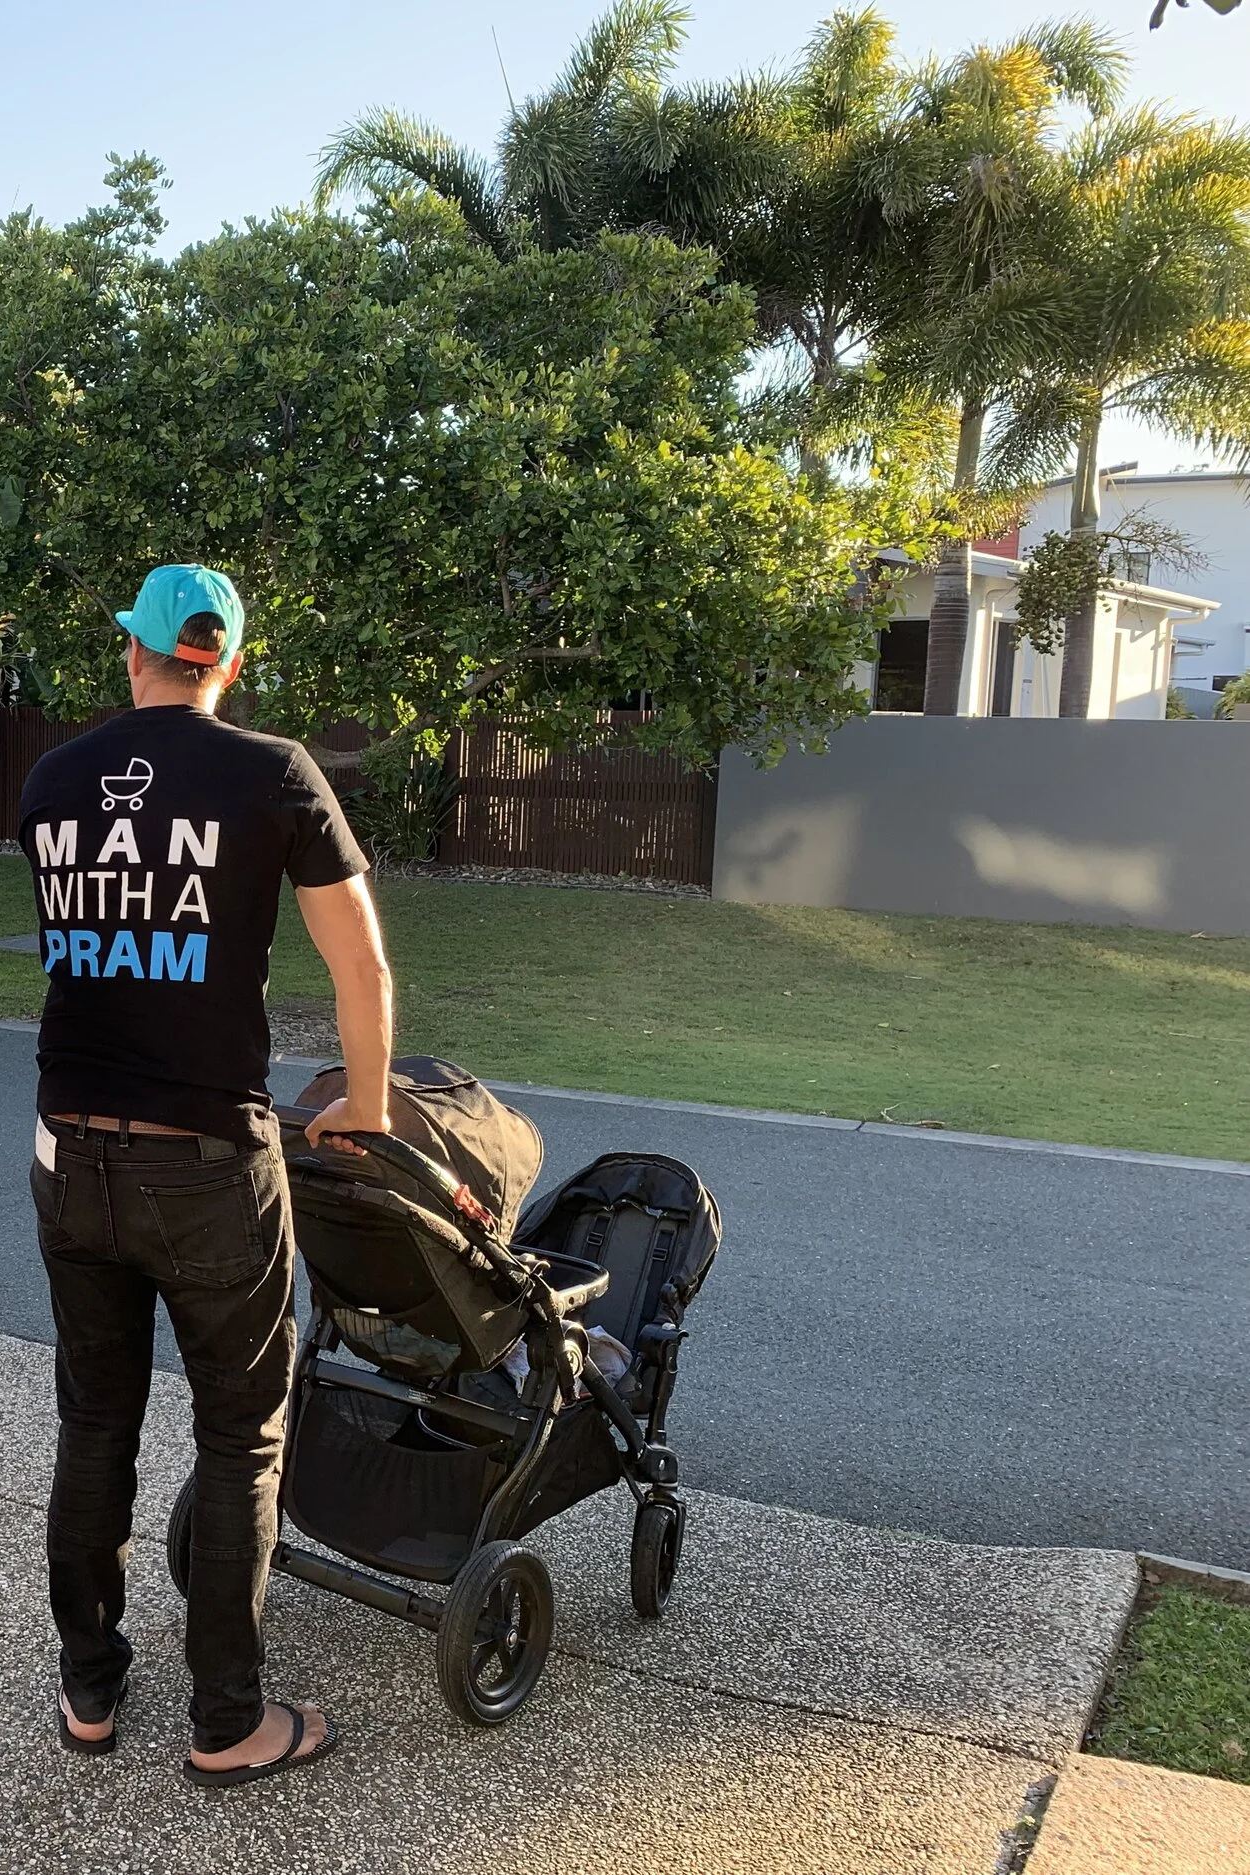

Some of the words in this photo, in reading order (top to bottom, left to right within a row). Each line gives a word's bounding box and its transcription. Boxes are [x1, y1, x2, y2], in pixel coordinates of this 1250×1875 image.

[35, 818, 220, 868] MAN
[40, 871, 153, 920] WITH
[170, 874, 210, 924] A
[44, 929, 208, 983] PRAM
